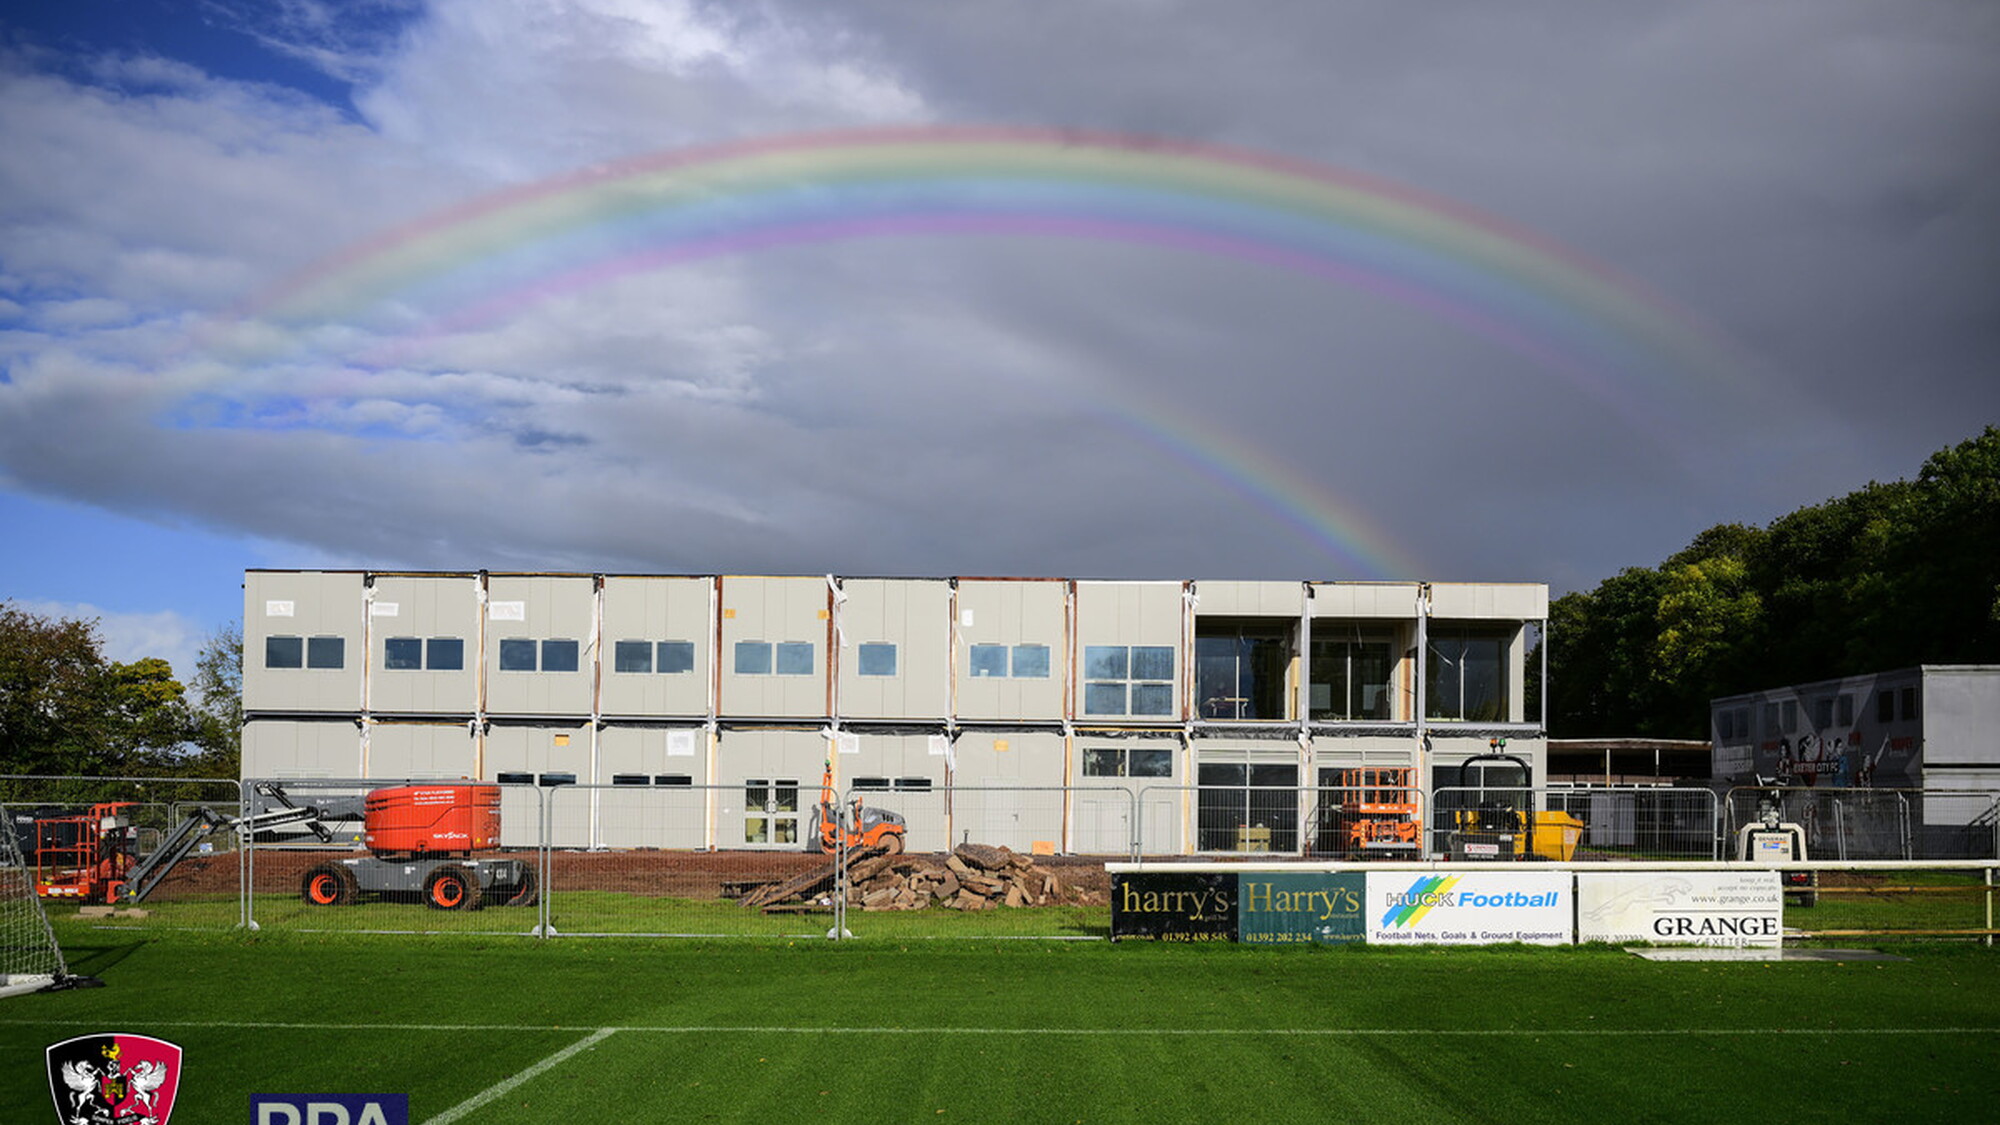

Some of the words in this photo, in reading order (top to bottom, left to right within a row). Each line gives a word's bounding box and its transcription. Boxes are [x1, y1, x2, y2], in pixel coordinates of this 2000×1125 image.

[1121, 882, 1229, 920] harry's
[1245, 882, 1360, 920] Harry's
[1386, 892, 1454, 907] HUCK
[1458, 892, 1559, 907] Football
[1691, 894, 1779, 905] www.grange.co.uk
[1653, 917, 1778, 936] GRANGE
[1162, 932, 1190, 941] 01392
[1246, 932, 1274, 942] 01392
[1276, 932, 1293, 942] 202
[1295, 932, 1312, 942] 234
[1376, 931, 1412, 939] Football
[1441, 931, 1467, 940] Goals
[1470, 931, 1477, 939] &
[1481, 931, 1513, 940] Ground
[1516, 931, 1563, 941] Equipment
[1705, 938, 1747, 946] EXETER
